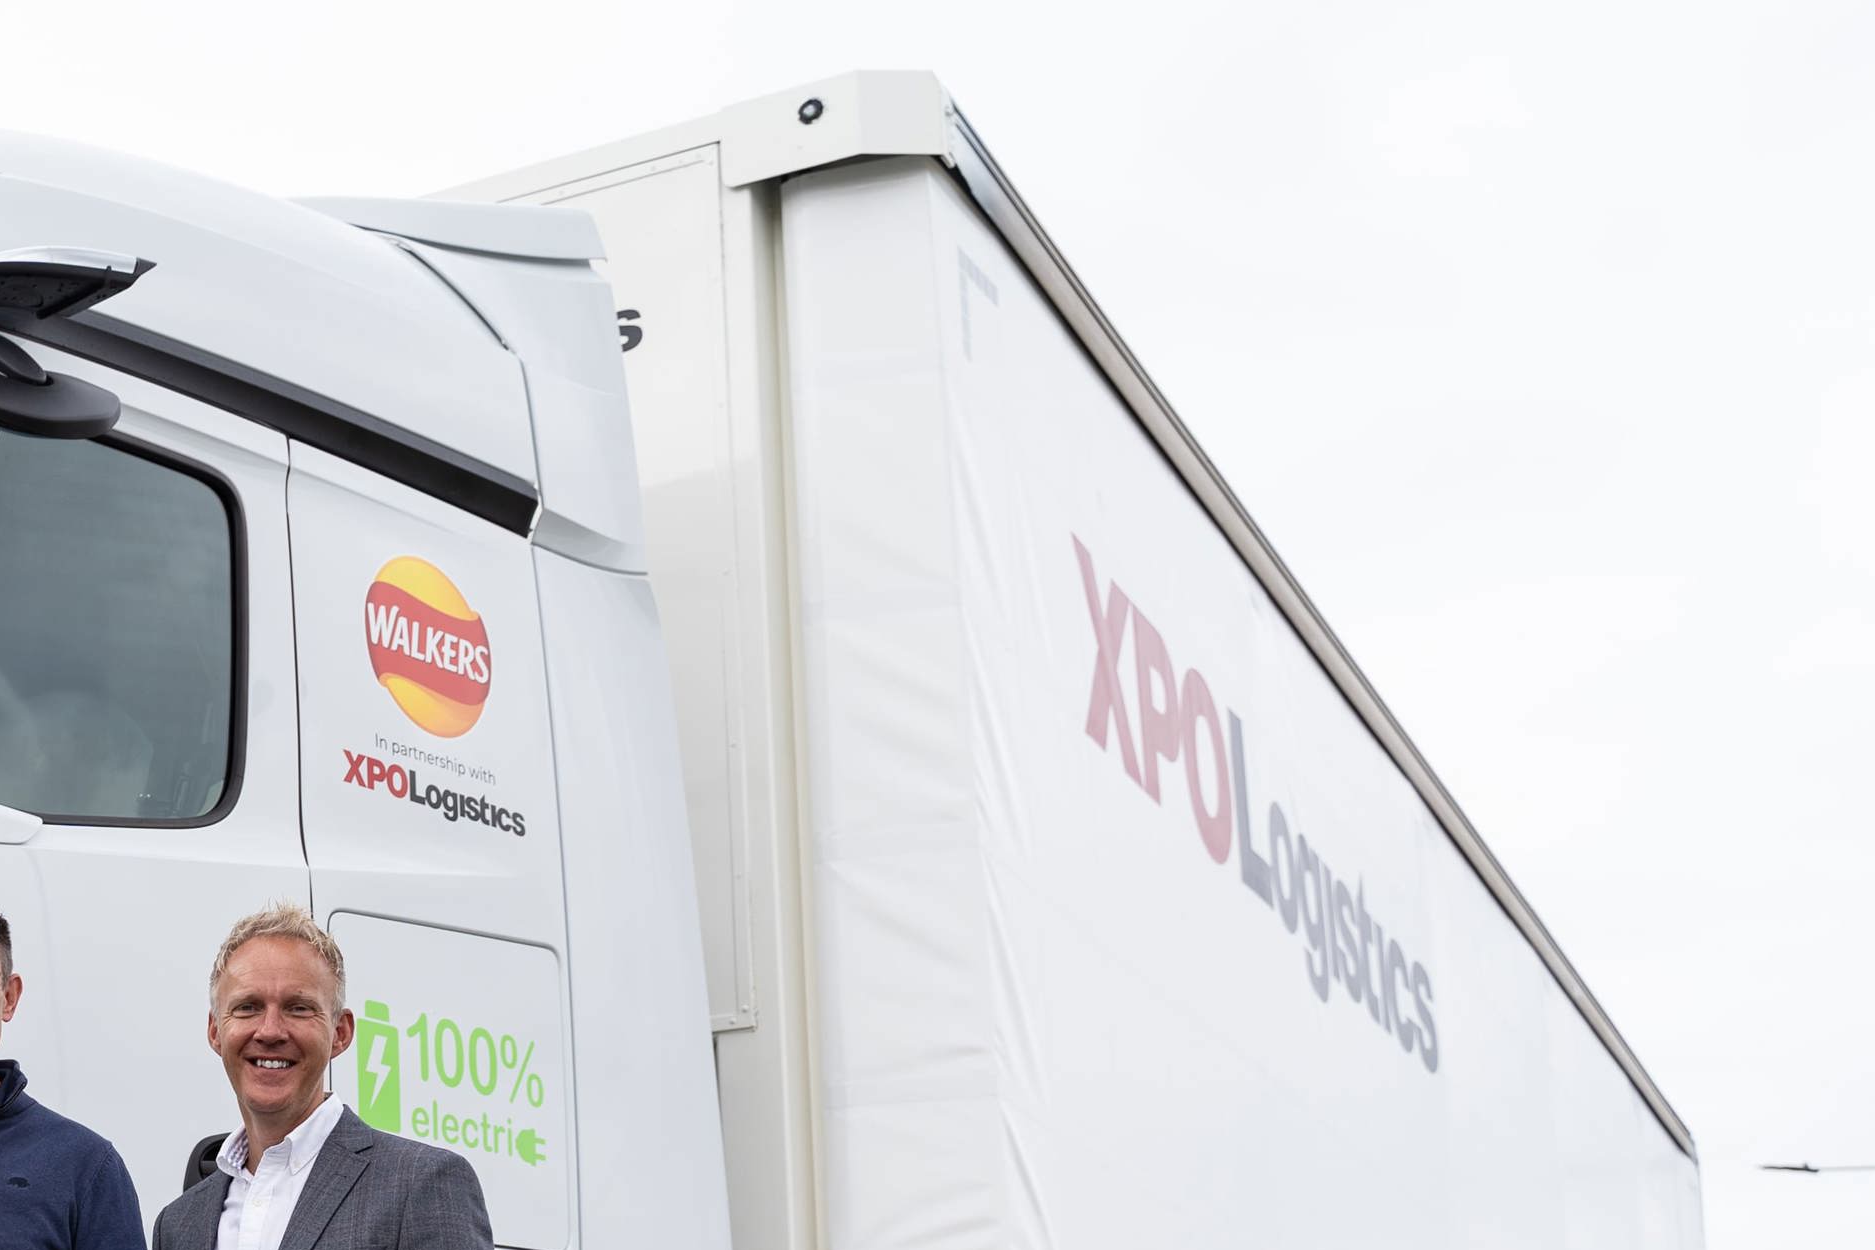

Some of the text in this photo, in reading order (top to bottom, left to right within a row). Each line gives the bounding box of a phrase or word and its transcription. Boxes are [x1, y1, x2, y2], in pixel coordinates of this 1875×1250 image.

[366, 602, 490, 684] WALKERS
[343, 749, 526, 837] XPOLogistics
[374, 732, 496, 786] In partnership with
[1071, 532, 1439, 1074] XPOLogistics
[406, 1012, 544, 1108] 100%
